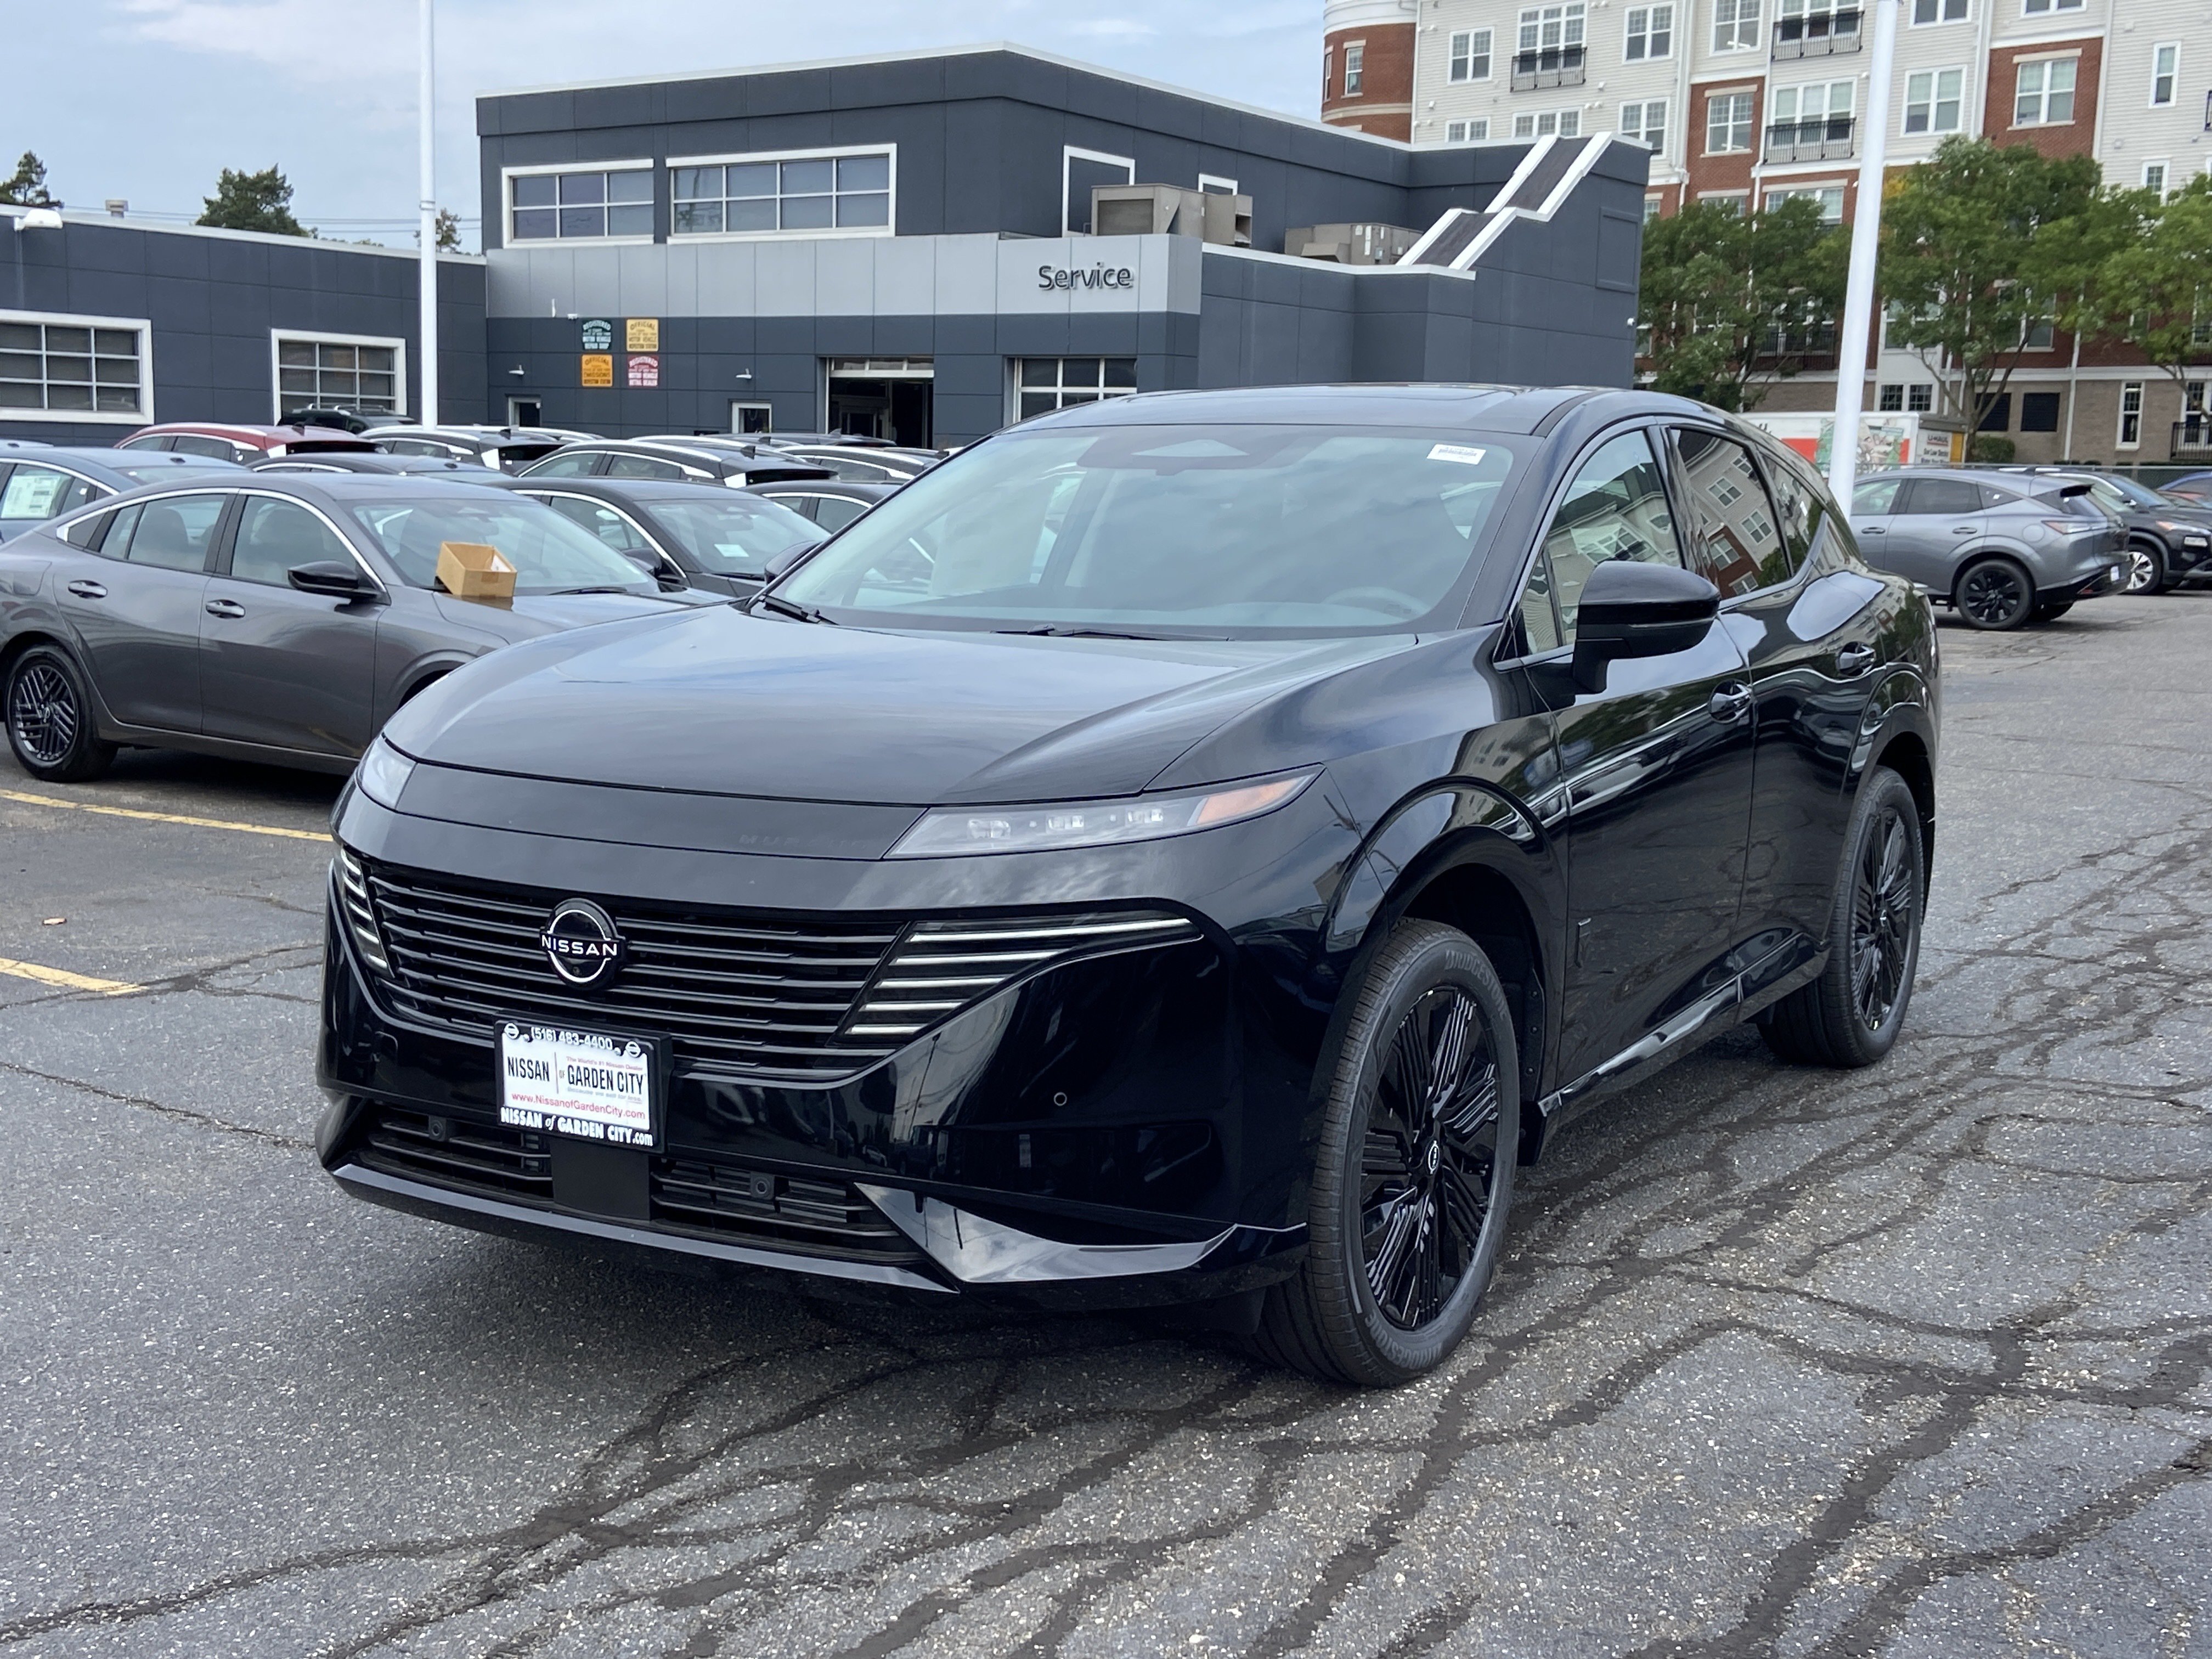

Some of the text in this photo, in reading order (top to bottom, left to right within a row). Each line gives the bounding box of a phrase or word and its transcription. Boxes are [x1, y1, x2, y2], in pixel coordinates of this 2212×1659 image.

[1038, 262, 1133, 289] Service
[541, 935, 617, 956] NISSAN
[1444, 948, 1508, 1020] BRIDGESTONE
[531, 1026, 613, 1051] (516) 483-4400
[507, 1056, 643, 1095] NISSAN OF GARDEN CITY
[511, 1093, 646, 1120] www.NissanofGardenCity.com
[500, 1107, 653, 1147] NISSAN of GARDEN CITY.com
